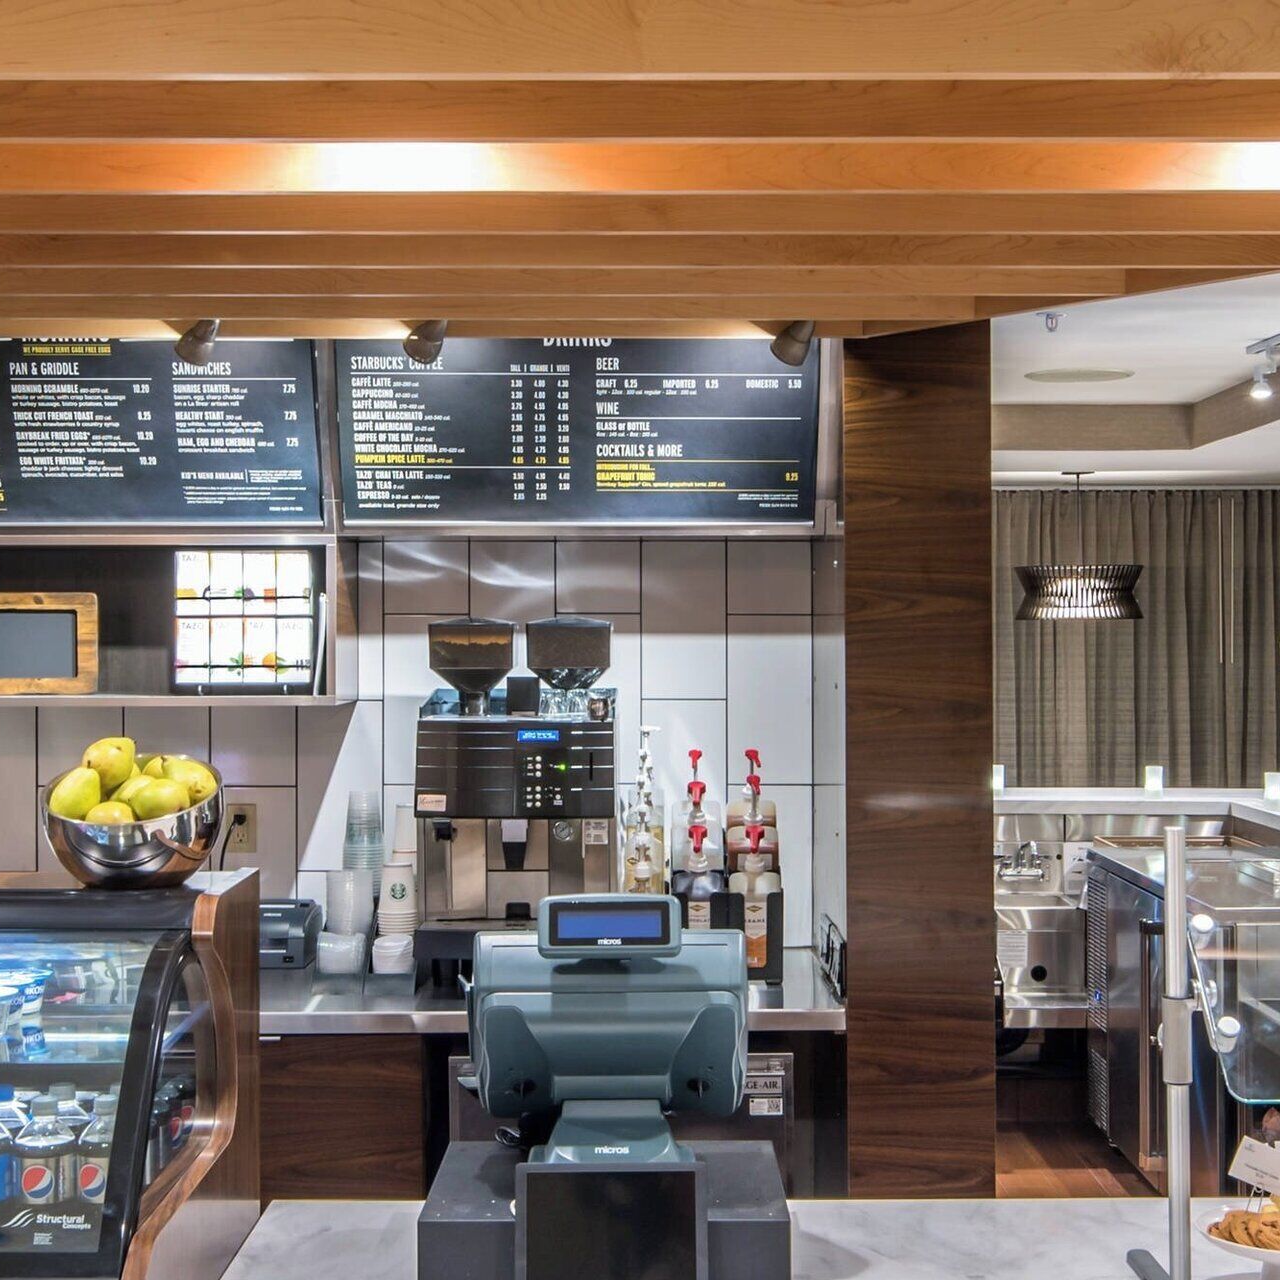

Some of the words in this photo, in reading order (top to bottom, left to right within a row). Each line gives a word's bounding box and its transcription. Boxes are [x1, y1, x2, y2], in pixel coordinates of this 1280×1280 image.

[9, 362, 28, 375] PAN
[31, 362, 38, 375] &
[41, 362, 80, 375] GRIDDLE
[172, 362, 232, 376] SANDWICHES
[596, 358, 619, 370] BEER
[596, 380, 617, 388] CRAFT
[596, 402, 620, 415] WINE
[596, 444, 644, 457] COCKTAILS
[648, 444, 654, 457] &
[657, 444, 683, 457] MORE
[594, 1145, 629, 1154] micros
[36, 1214, 85, 1224] Structural
